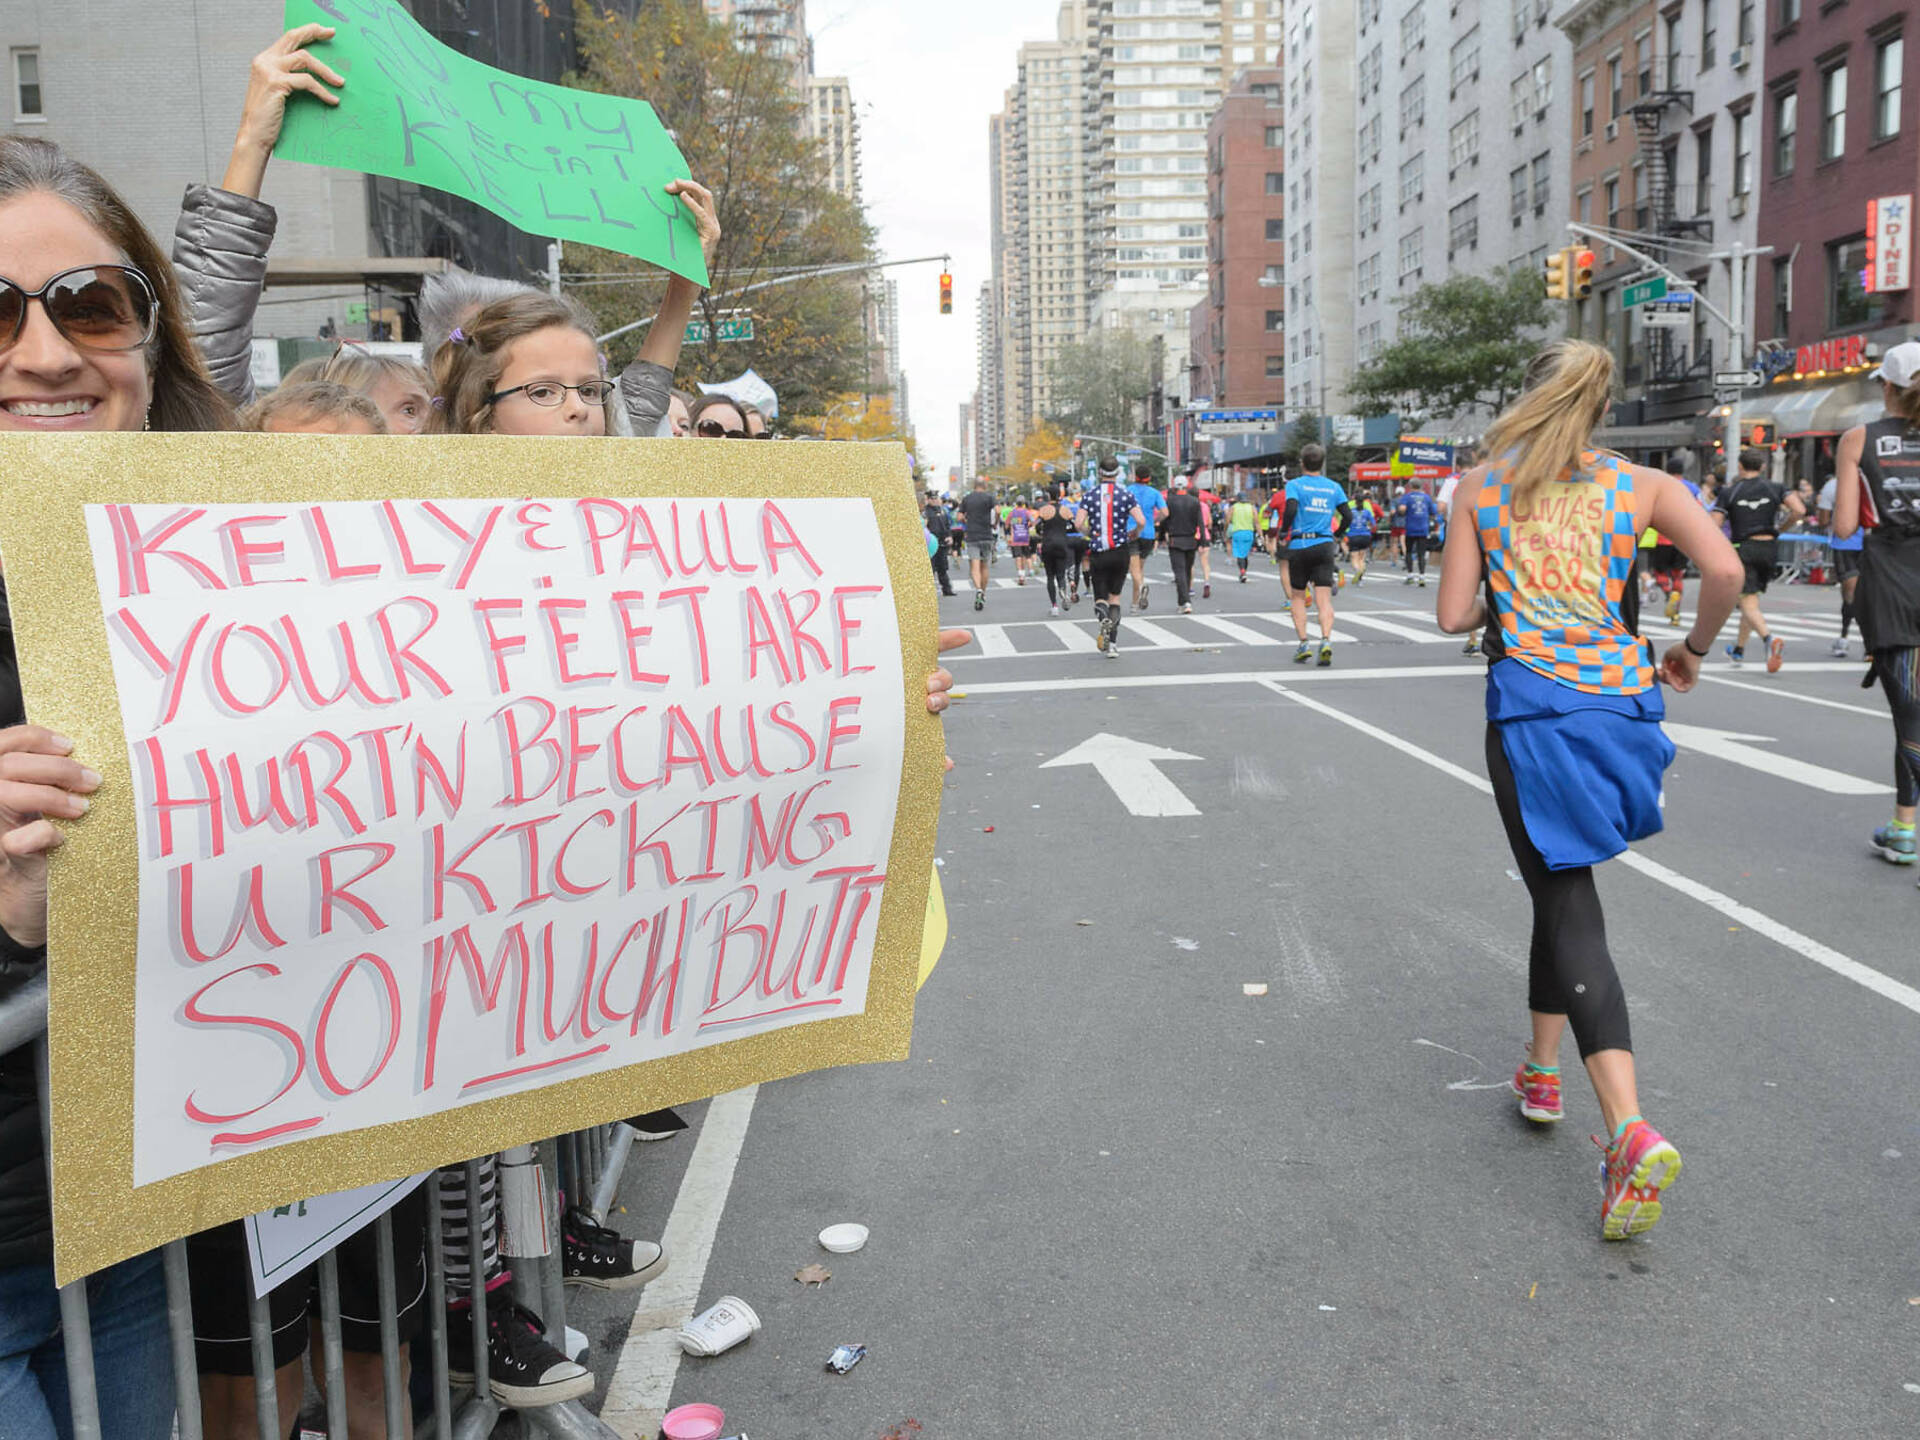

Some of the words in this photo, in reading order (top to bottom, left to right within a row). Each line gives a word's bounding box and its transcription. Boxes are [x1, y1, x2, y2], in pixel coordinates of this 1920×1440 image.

[394, 93, 681, 261] KELLY
[1884, 223, 1902, 287] DINER
[1796, 334, 1867, 375] DINER
[104, 499, 503, 598] KELLY
[574, 496, 825, 580] PAULA
[1521, 553, 1595, 595] 26.2
[108, 594, 455, 731] YOUR
[472, 585, 711, 695] FEET
[736, 585, 884, 687] ARE
[487, 695, 864, 811] BECAUSE
[168, 861, 288, 968] U
[308, 841, 397, 938] R
[415, 778, 852, 928] KICKING
[173, 951, 400, 1125] SO
[413, 889, 694, 1094] MUCH
[694, 864, 886, 1012] BUTT
